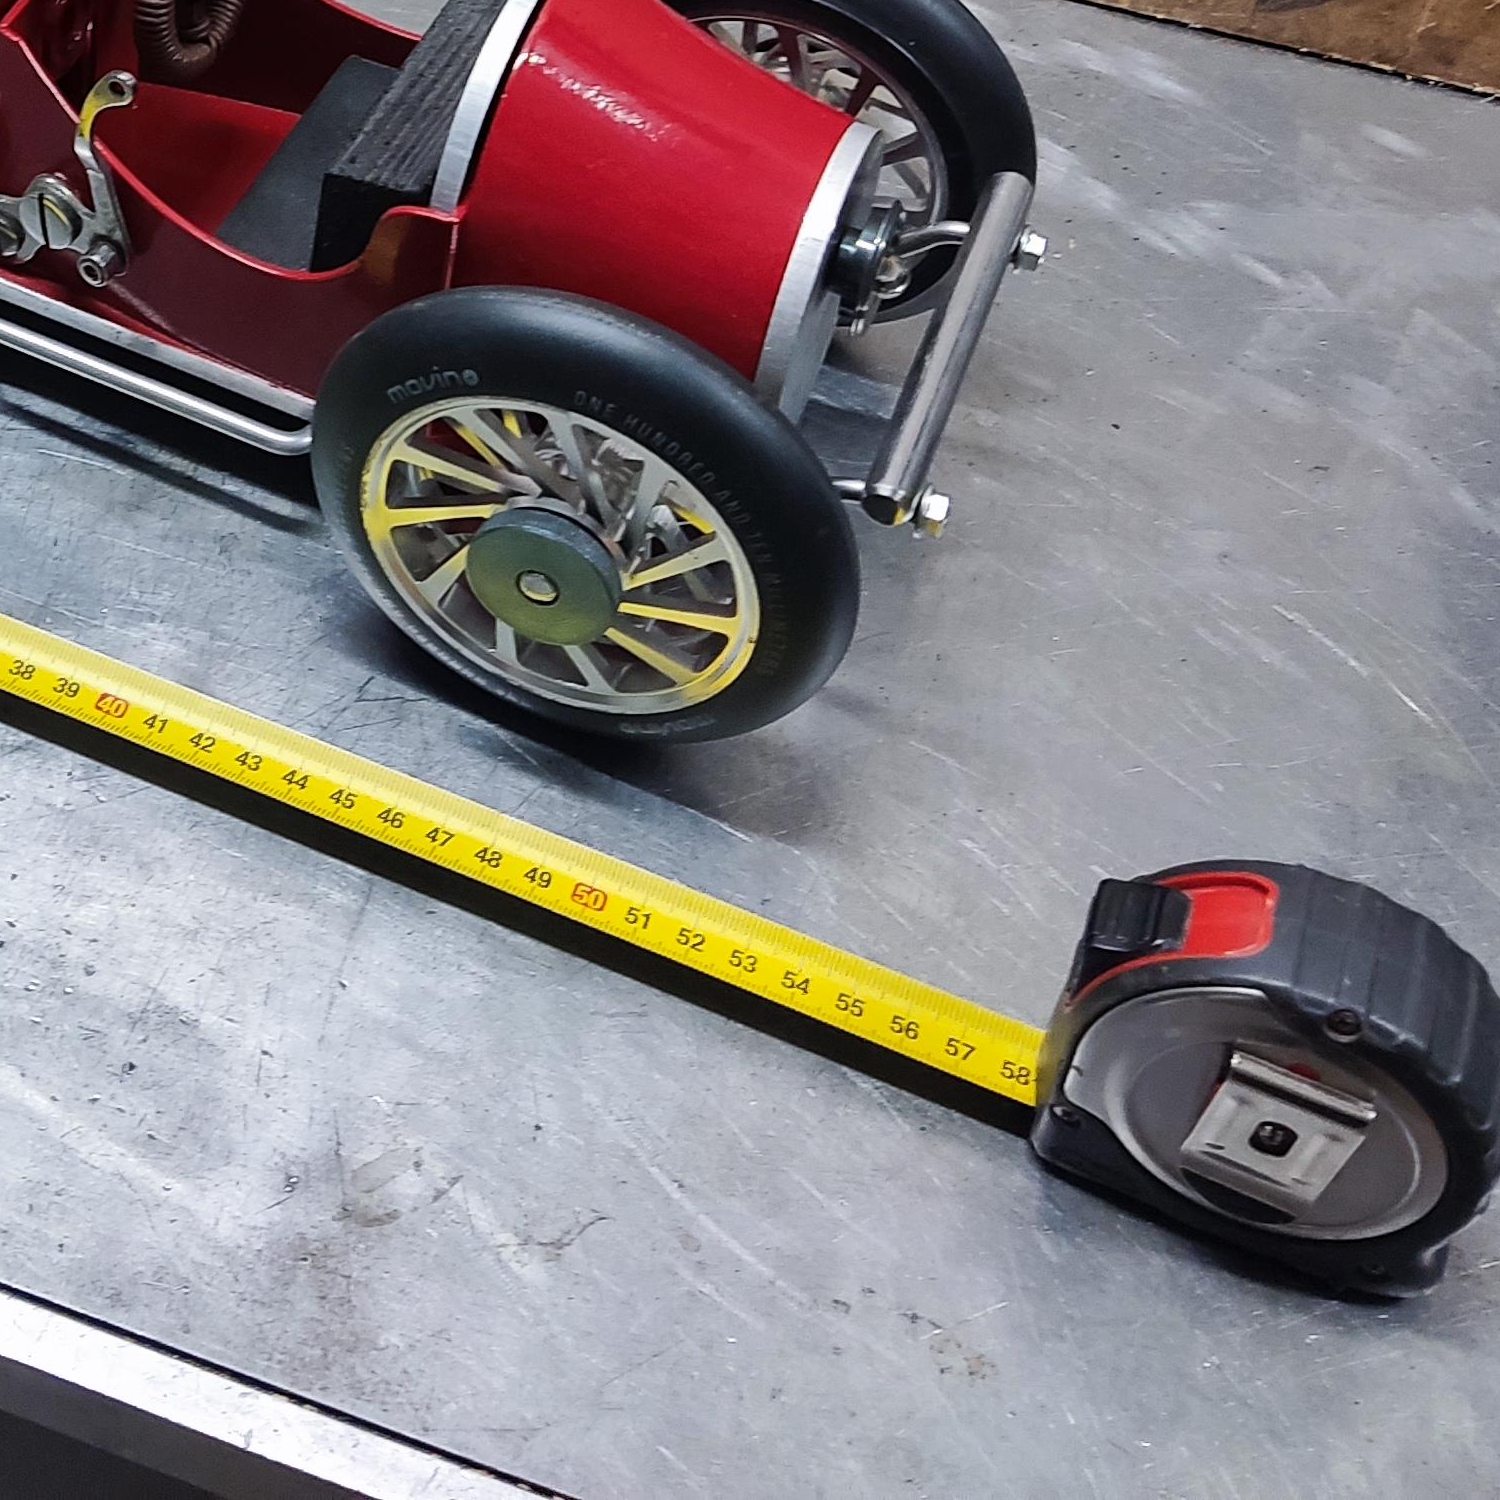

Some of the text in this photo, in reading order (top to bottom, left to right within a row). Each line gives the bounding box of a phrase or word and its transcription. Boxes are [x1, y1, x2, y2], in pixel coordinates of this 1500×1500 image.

[386, 365, 480, 404] movino
[573, 390, 618, 417] ONE
[623, 413, 717, 486] HUNDRED
[713, 489, 751, 524] AND
[8, 659, 36, 681] 38
[52, 677, 80, 698] 39
[97, 695, 128, 717] 40
[143, 713, 169, 735] 41
[188, 732, 216, 754] 42
[234, 750, 263, 772] 43
[281, 768, 309, 791] 44
[329, 788, 356, 810] 45
[376, 807, 405, 830] 46
[425, 826, 455, 848] 47
[474, 846, 503, 869] 48
[523, 866, 553, 889] 49
[573, 884, 606, 910] 50
[624, 906, 653, 930] 51
[675, 927, 707, 953] 52
[728, 949, 759, 974] 53
[781, 970, 811, 995] 54
[835, 992, 866, 1018] 55
[890, 1015, 920, 1041] 56
[944, 1037, 976, 1062] 57
[1000, 1060, 1031, 1086] 58
